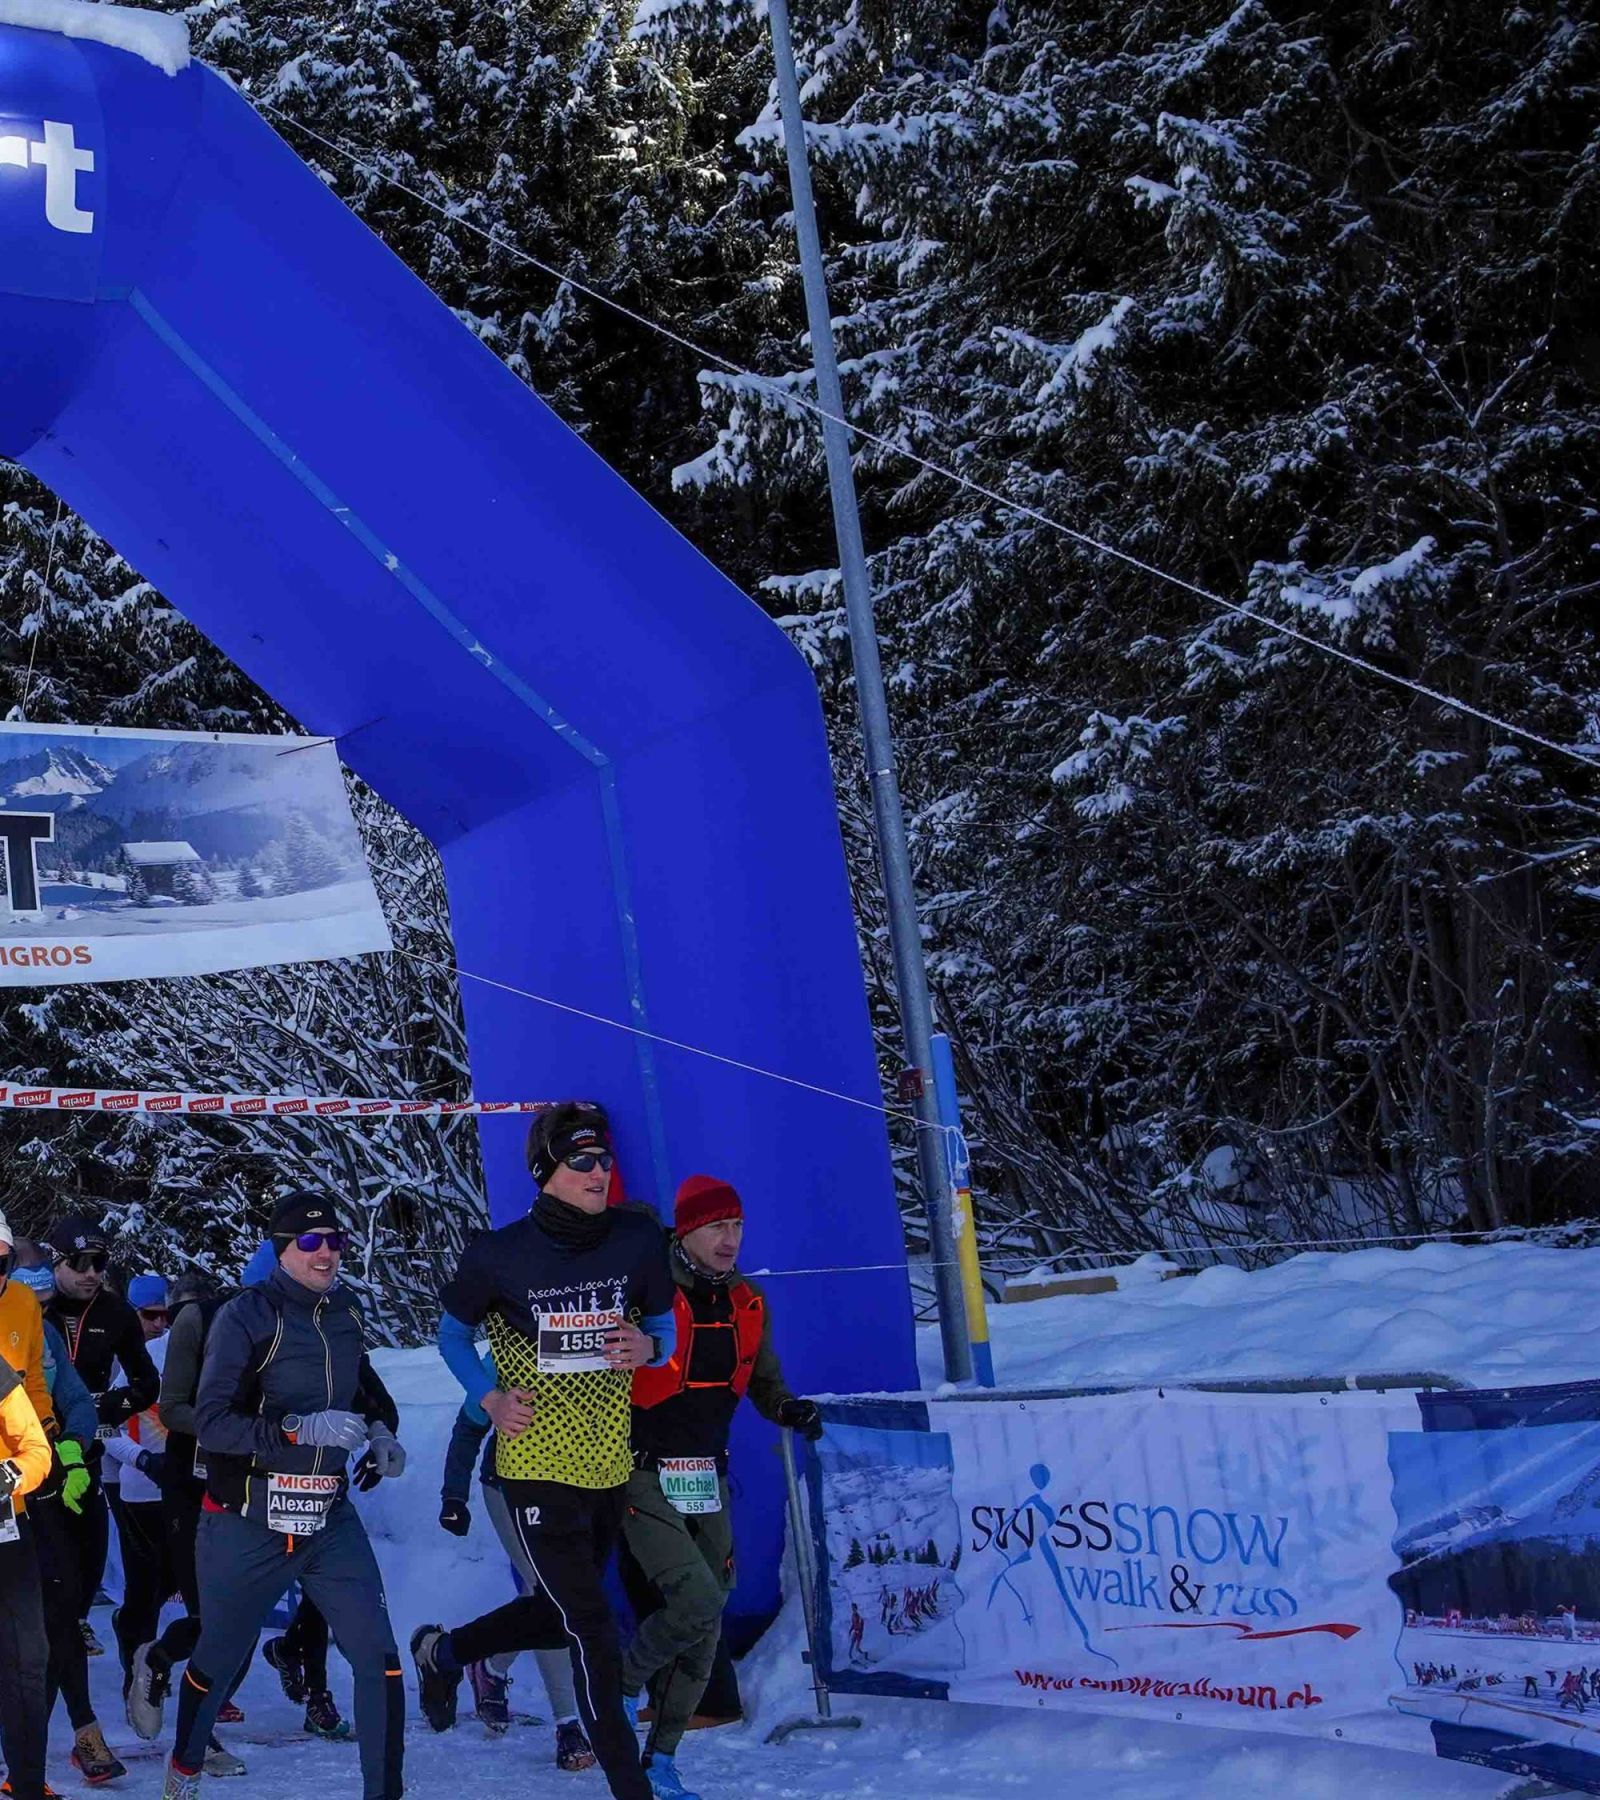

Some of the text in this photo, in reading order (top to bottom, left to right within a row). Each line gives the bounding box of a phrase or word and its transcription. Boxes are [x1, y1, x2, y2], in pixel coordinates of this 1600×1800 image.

[18, 1091, 48, 1104] rivella
[63, 1093, 91, 1107] rivella
[106, 1095, 135, 1107] rivella
[150, 1096, 178, 1108] rivella
[192, 1098, 220, 1111] rivella
[233, 1100, 263, 1112] rivella
[528, 1275, 628, 1300] Ascona-Locarno
[549, 1311, 618, 1328] MIGROS
[560, 1332, 605, 1351] 1555
[666, 1460, 714, 1472] MIGROS
[277, 1475, 337, 1490] MIGROS
[686, 1501, 705, 1512] 559
[525, 1506, 541, 1525] 12
[1065, 1559, 1298, 1617] walk & run
